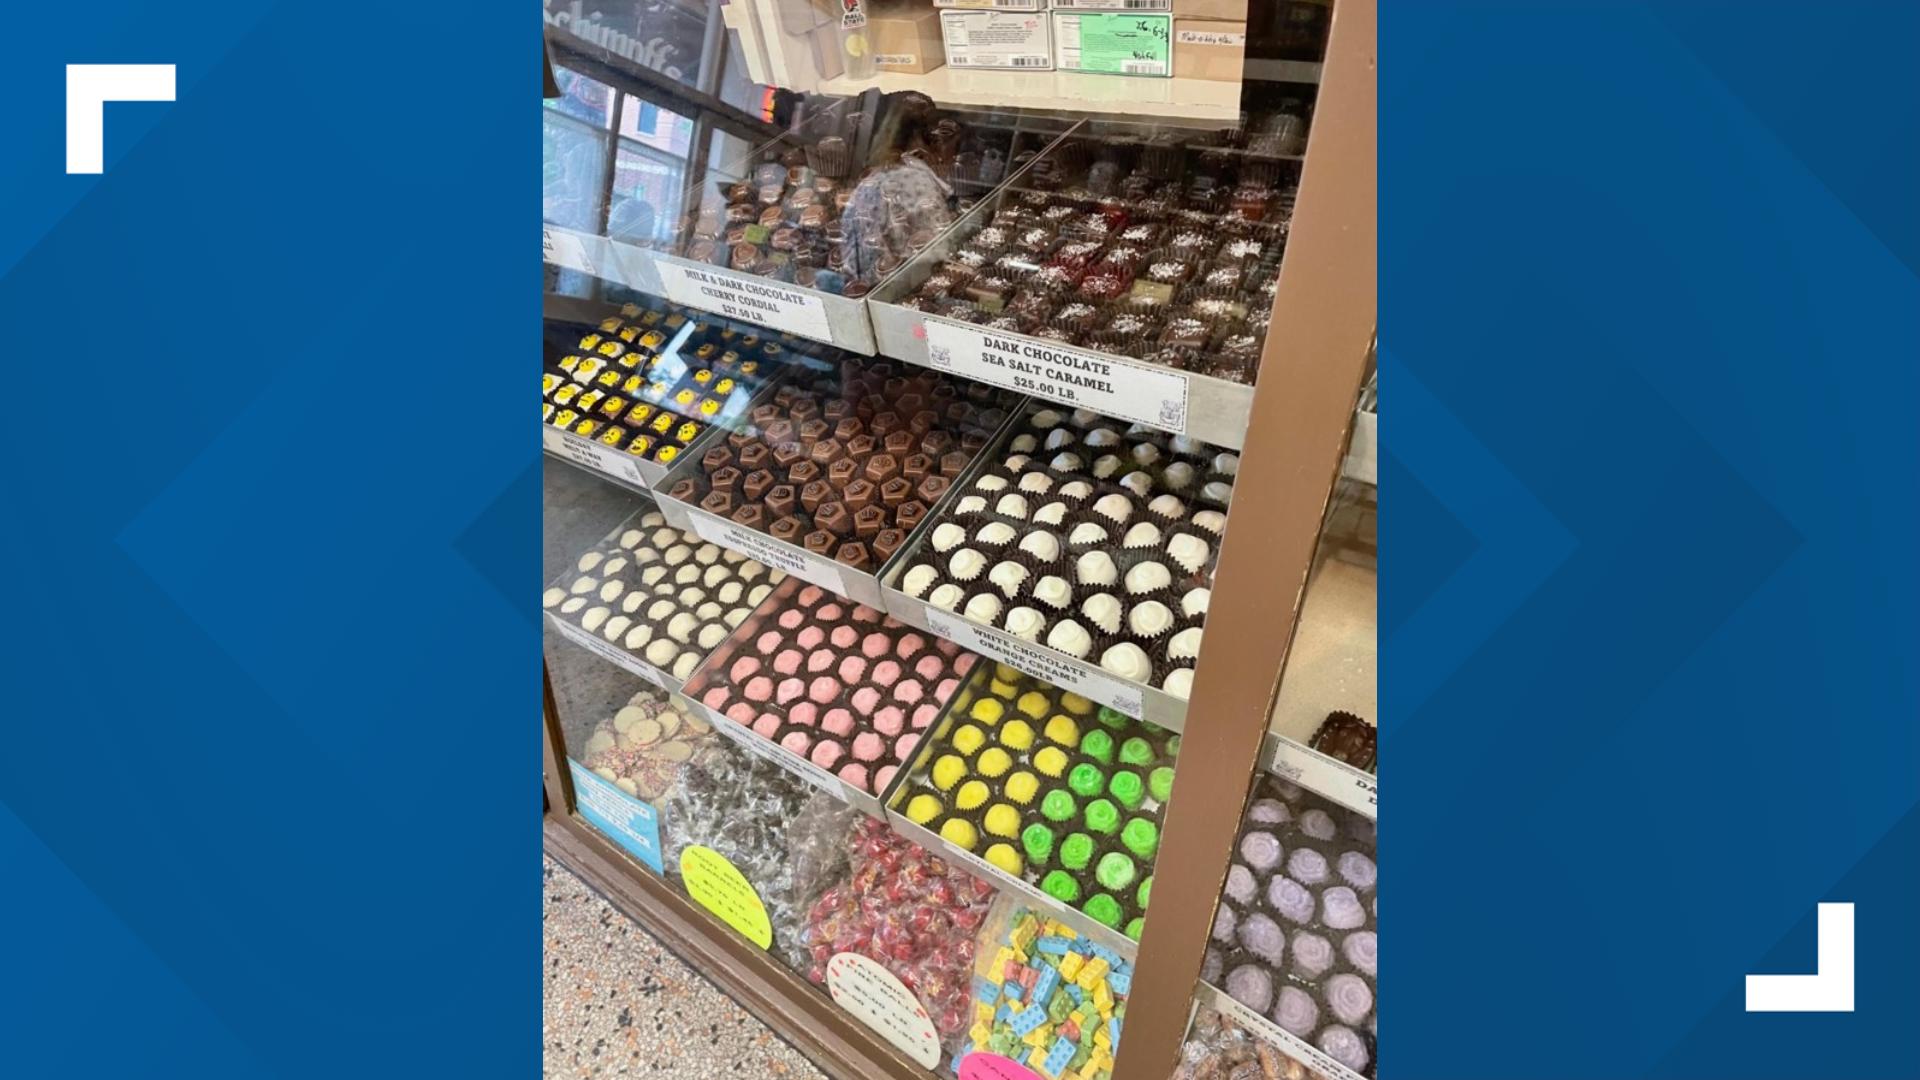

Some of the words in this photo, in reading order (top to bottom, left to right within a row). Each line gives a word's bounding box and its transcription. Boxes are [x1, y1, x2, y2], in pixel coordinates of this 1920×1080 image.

[684, 269, 708, 284] MILK
[718, 278, 744, 291] DARK
[745, 283, 805, 306] CHOCOLATE
[701, 286, 736, 303] CHERRY
[738, 294, 780, 313] CORDIAL
[981, 352, 1006, 367] SEA
[1008, 358, 1041, 376] SALT
[1045, 368, 1114, 394] CARAMEL
[983, 336, 1020, 355] DARK
[1023, 346, 1110, 376] CHOCOLATE
[1013, 375, 1055, 395] $25.00
[1058, 386, 1080, 402] LB.
[730, 529, 752, 542] MILK
[753, 537, 806, 565] CHOCOLATE
[972, 627, 1012, 649] WHITE
[1012, 644, 1088, 679] CHOCOLATE
[979, 638, 1026, 664] ORANGE
[1028, 659, 1079, 684] CREAMS
[846, 963, 874, 985] FIRE
[857, 963, 906, 999] ATOMIC
